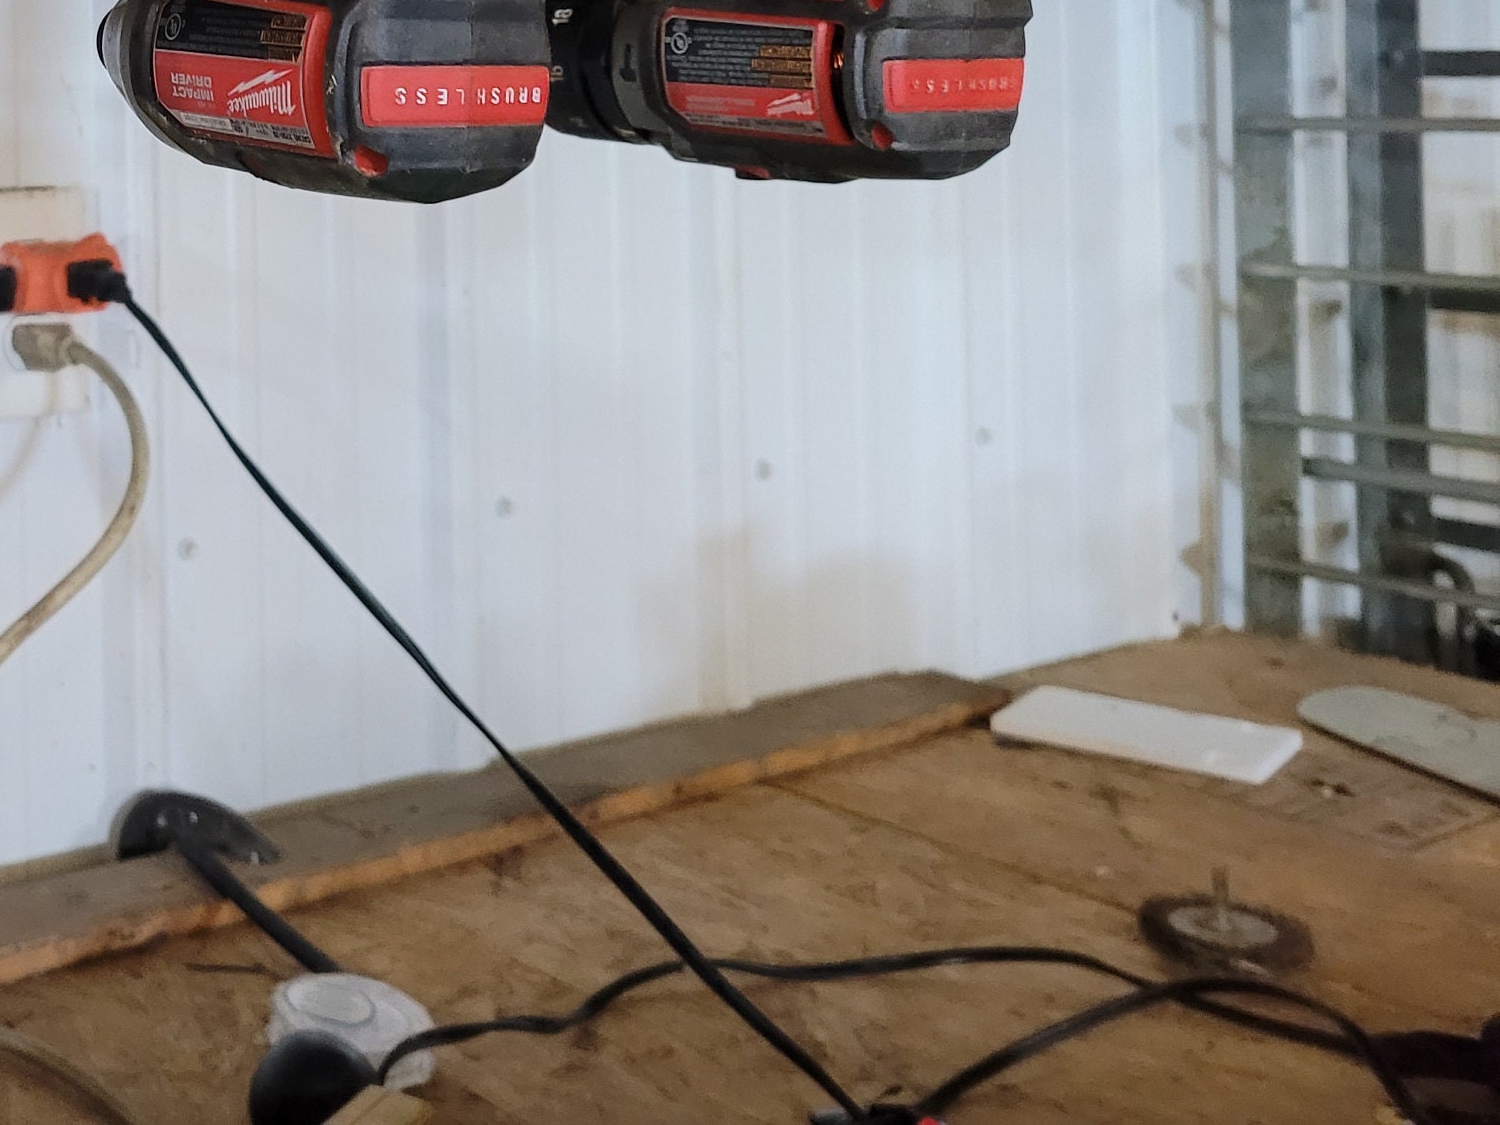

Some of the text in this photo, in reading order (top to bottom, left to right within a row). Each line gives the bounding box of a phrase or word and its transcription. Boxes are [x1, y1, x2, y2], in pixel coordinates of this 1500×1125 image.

[553, 8, 572, 26] 18
[171, 72, 213, 87] DRIVER
[172, 86, 214, 102] IMPACT
[227, 80, 296, 118] Milwaukee
[394, 87, 541, 106] BRUSHLESS
